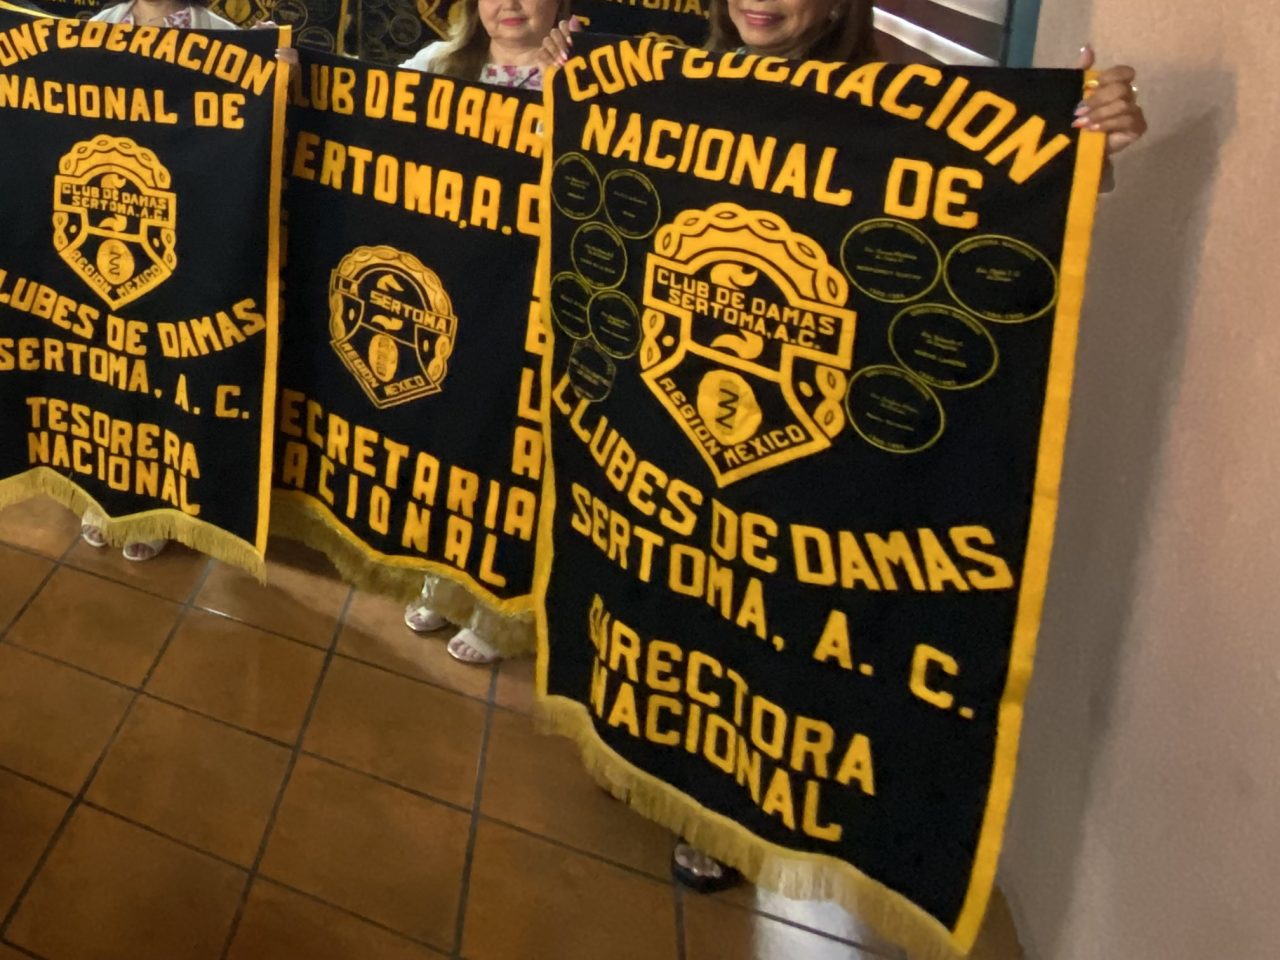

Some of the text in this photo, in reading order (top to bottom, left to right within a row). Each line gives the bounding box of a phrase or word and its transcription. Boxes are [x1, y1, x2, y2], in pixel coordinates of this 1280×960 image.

[194, 91, 246, 129] DE
[364, 68, 420, 123] DE
[426, 78, 545, 158] DAMA
[564, 36, 1070, 184] CONFEDERACION
[62, 183, 167, 210] CLUB DE DAMAS
[581, 104, 984, 229] NACIONAL DE
[71, 250, 161, 298] REGION MEXICO
[370, 290, 449, 332] SERTOMA
[657, 268, 835, 335] CLUB DE DAMAS
[106, 313, 148, 356] DE
[157, 297, 267, 358] DAMAS
[341, 342, 425, 397] REGION MEXICO
[26, 396, 200, 478] TESORERA
[215, 384, 250, 419] C.
[659, 377, 806, 468] REGION MEXICO
[27, 431, 201, 516] NACIONAL
[280, 389, 537, 541] ECRETARIA
[552, 371, 1014, 592] CLUBES DE DAMAS
[283, 442, 507, 587] ACIONAL
[813, 609, 875, 676] A.
[909, 643, 975, 720] C.
[590, 656, 843, 843] NACIONAL
